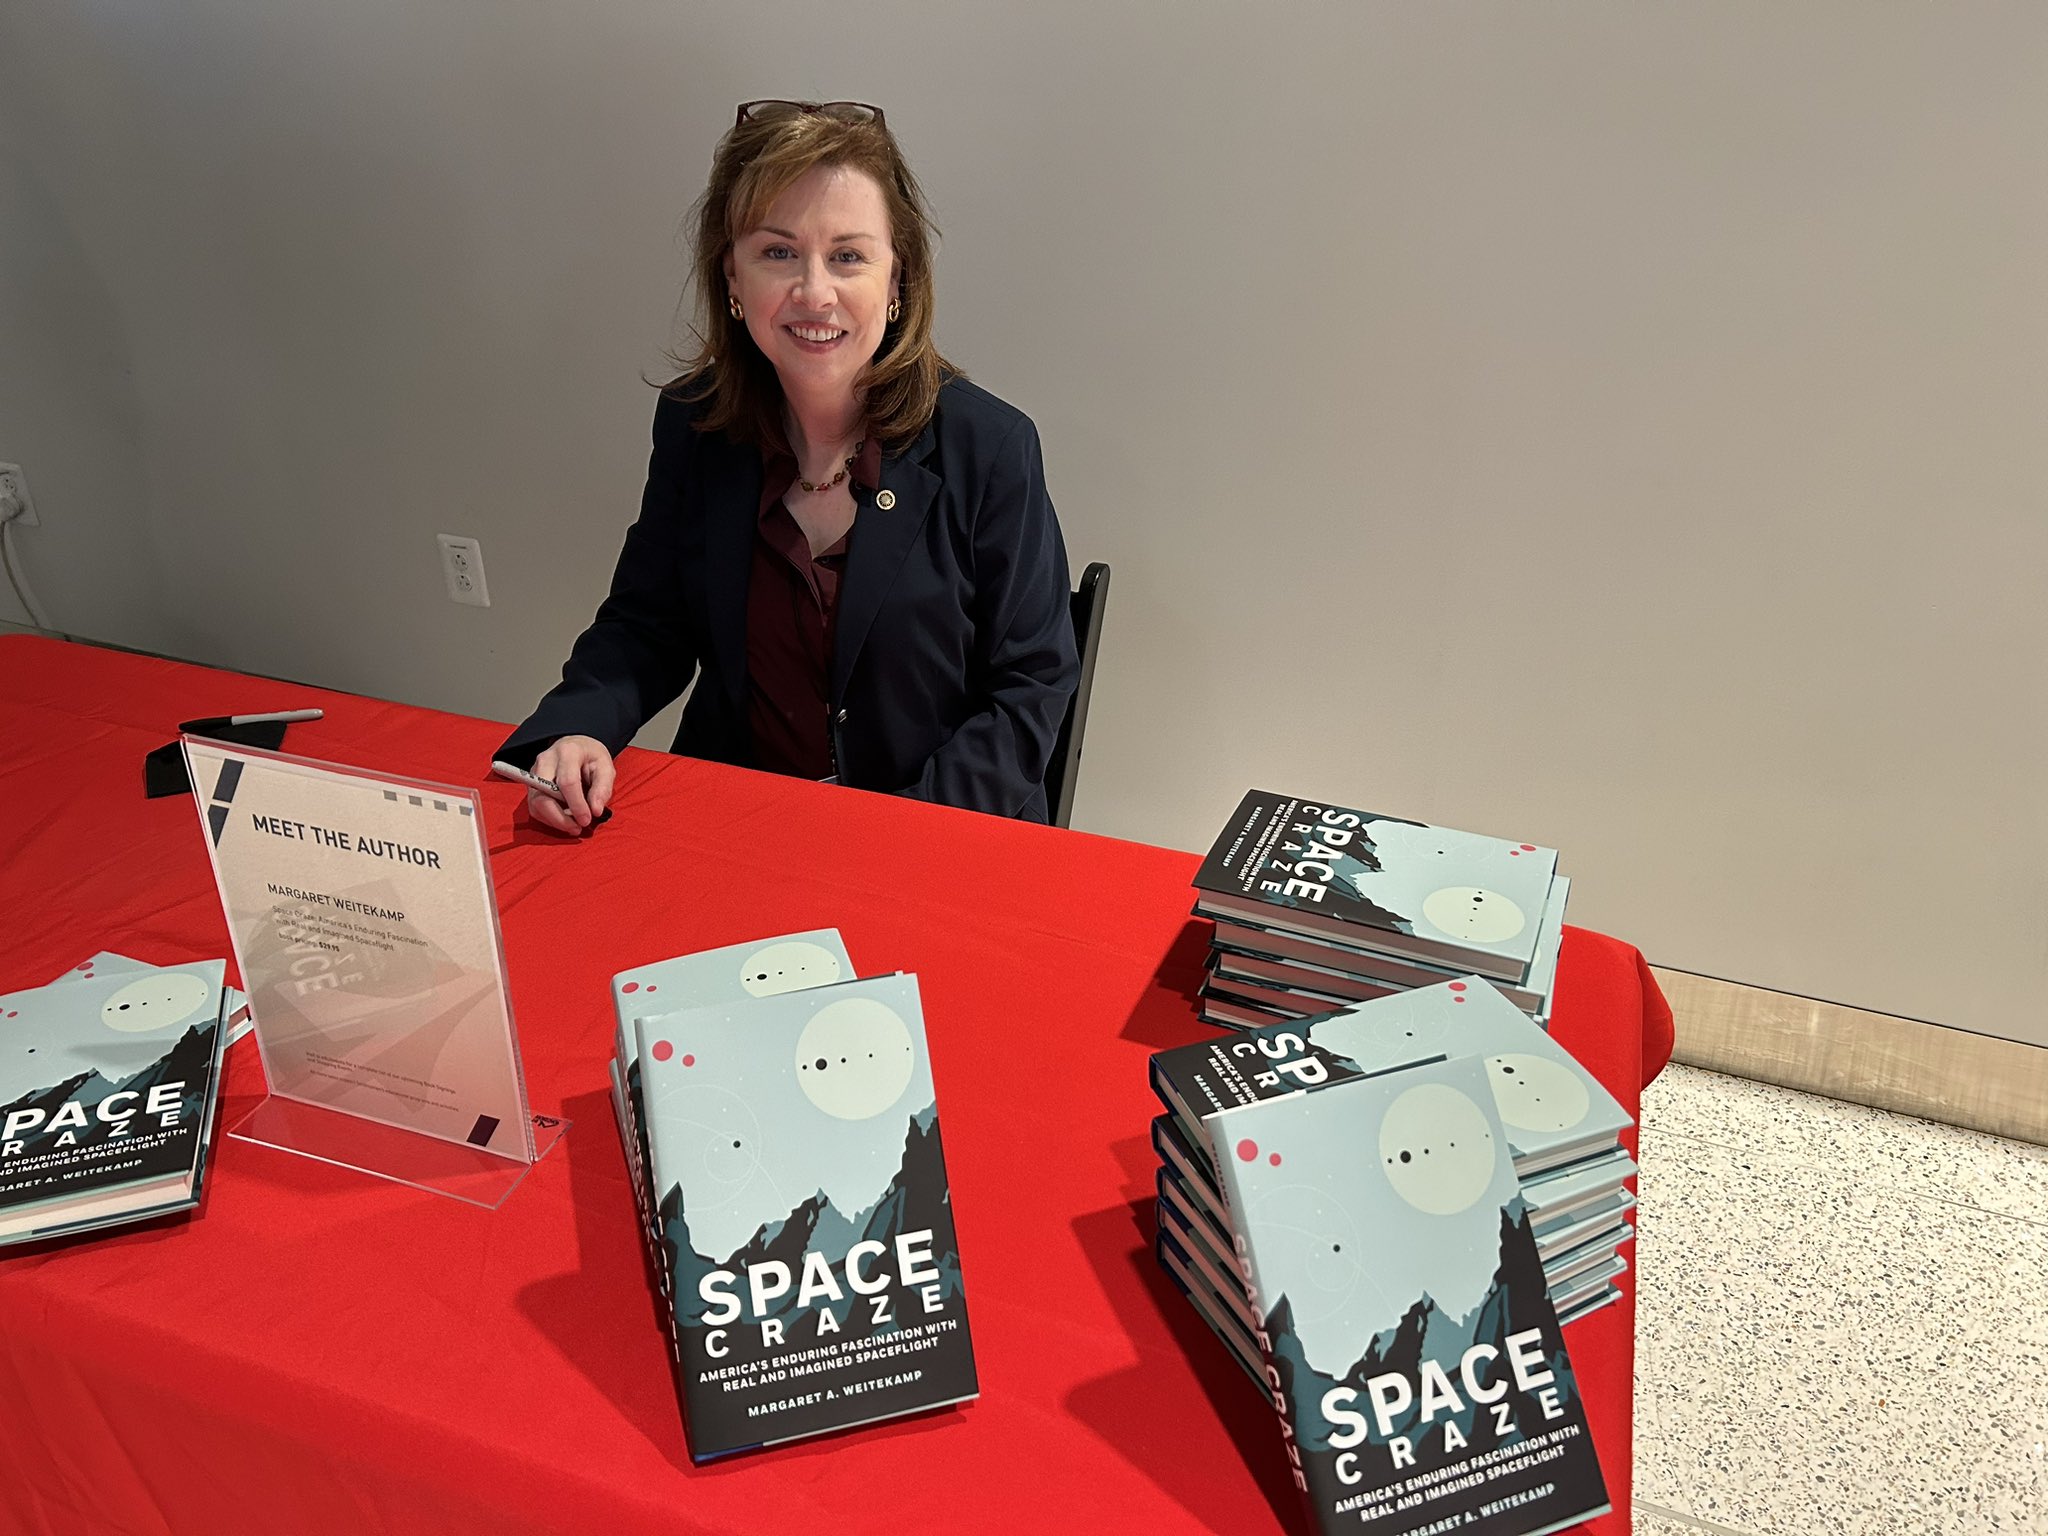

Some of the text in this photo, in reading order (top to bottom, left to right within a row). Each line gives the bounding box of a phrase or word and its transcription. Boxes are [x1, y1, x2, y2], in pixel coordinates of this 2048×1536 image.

[1243, 806, 1263, 832] MARGARET
[1255, 825, 1274, 848] IMAGINED
[1267, 822, 1286, 846] ENDURING
[252, 813, 441, 869] MEET THE AUTHOR
[1222, 837, 1245, 867] WEITEKAMP
[1250, 844, 1273, 877] FASCINATION
[1260, 804, 1322, 894] CRAZE
[1282, 809, 1360, 903] SPACE
[1237, 846, 1261, 881] SPACEFLIGHT
[1242, 876, 1256, 892] WITH
[267, 882, 405, 922] MARGARET WEITEKAMP
[308, 925, 321, 934] and
[322, 927, 355, 941] Imagined
[355, 935, 394, 951] Spaceflight
[354, 924, 386, 940] Enduring
[387, 931, 429, 948] Fascination
[1207, 1057, 1239, 1094] REAL AND
[1209, 1044, 1243, 1083] AMERICA'S
[0, 1081, 186, 1141] PACE
[1193, 1074, 1226, 1112] MARGARE
[0, 1110, 181, 1157] RAZE
[4, 1128, 188, 1168] ENDURING FASCINATION WITH
[17, 1155, 80, 1173] IMAGINED
[83, 1138, 167, 1161] SPACEFLIGHT
[44, 1174, 58, 1184] A.
[62, 1159, 143, 1180] WEITEKAMP
[698, 1229, 940, 1326] SPACE
[704, 1284, 945, 1359] CRAZE
[699, 1318, 957, 1383] AMERICA'S ENDURING FASCINATION WITH
[722, 1336, 938, 1392] REAL AND IMAGINED SPACEFLIGHT
[1233, 1234, 1308, 1492] SPACE CRAZE
[748, 1370, 923, 1417] MARGARET A. WEITEKAMP
[1321, 1327, 1555, 1449] SPACE
[1335, 1387, 1565, 1485] CRAZE
[1335, 1424, 1580, 1513] AMERICA'S ENDURING FASCINATION WITH
[1360, 1445, 1565, 1522] REAL AND IMAGINED SPACEFLIGHT
[1464, 1509, 1479, 1524] A.
[1480, 1482, 1556, 1517] WEITEKAMP
